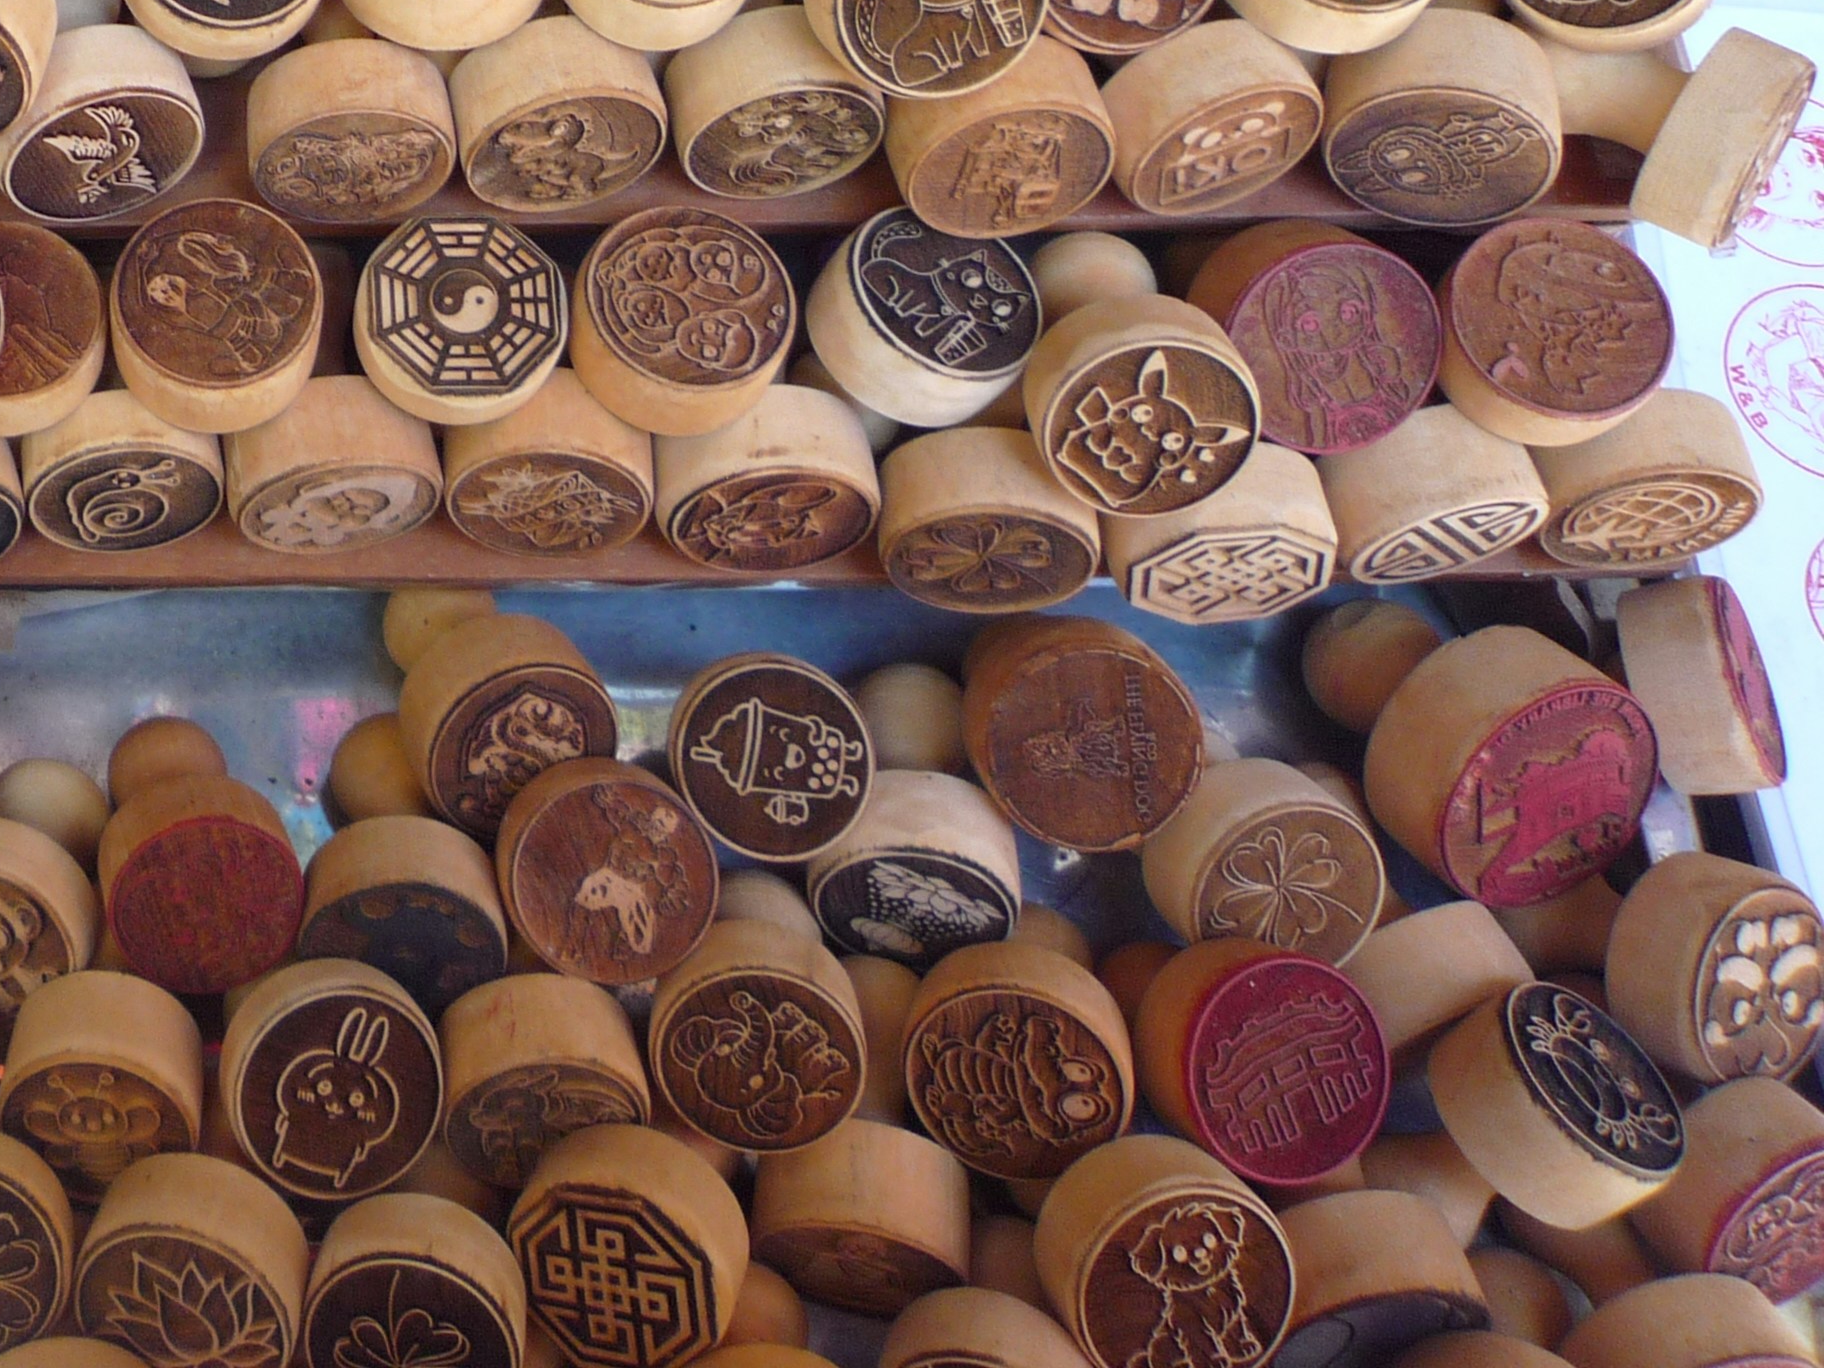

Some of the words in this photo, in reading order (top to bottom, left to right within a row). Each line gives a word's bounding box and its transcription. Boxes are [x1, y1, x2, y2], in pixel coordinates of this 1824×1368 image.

[1730, 364, 1748, 383] W
[1739, 392, 1754, 407] &
[1750, 411, 1768, 429] B
